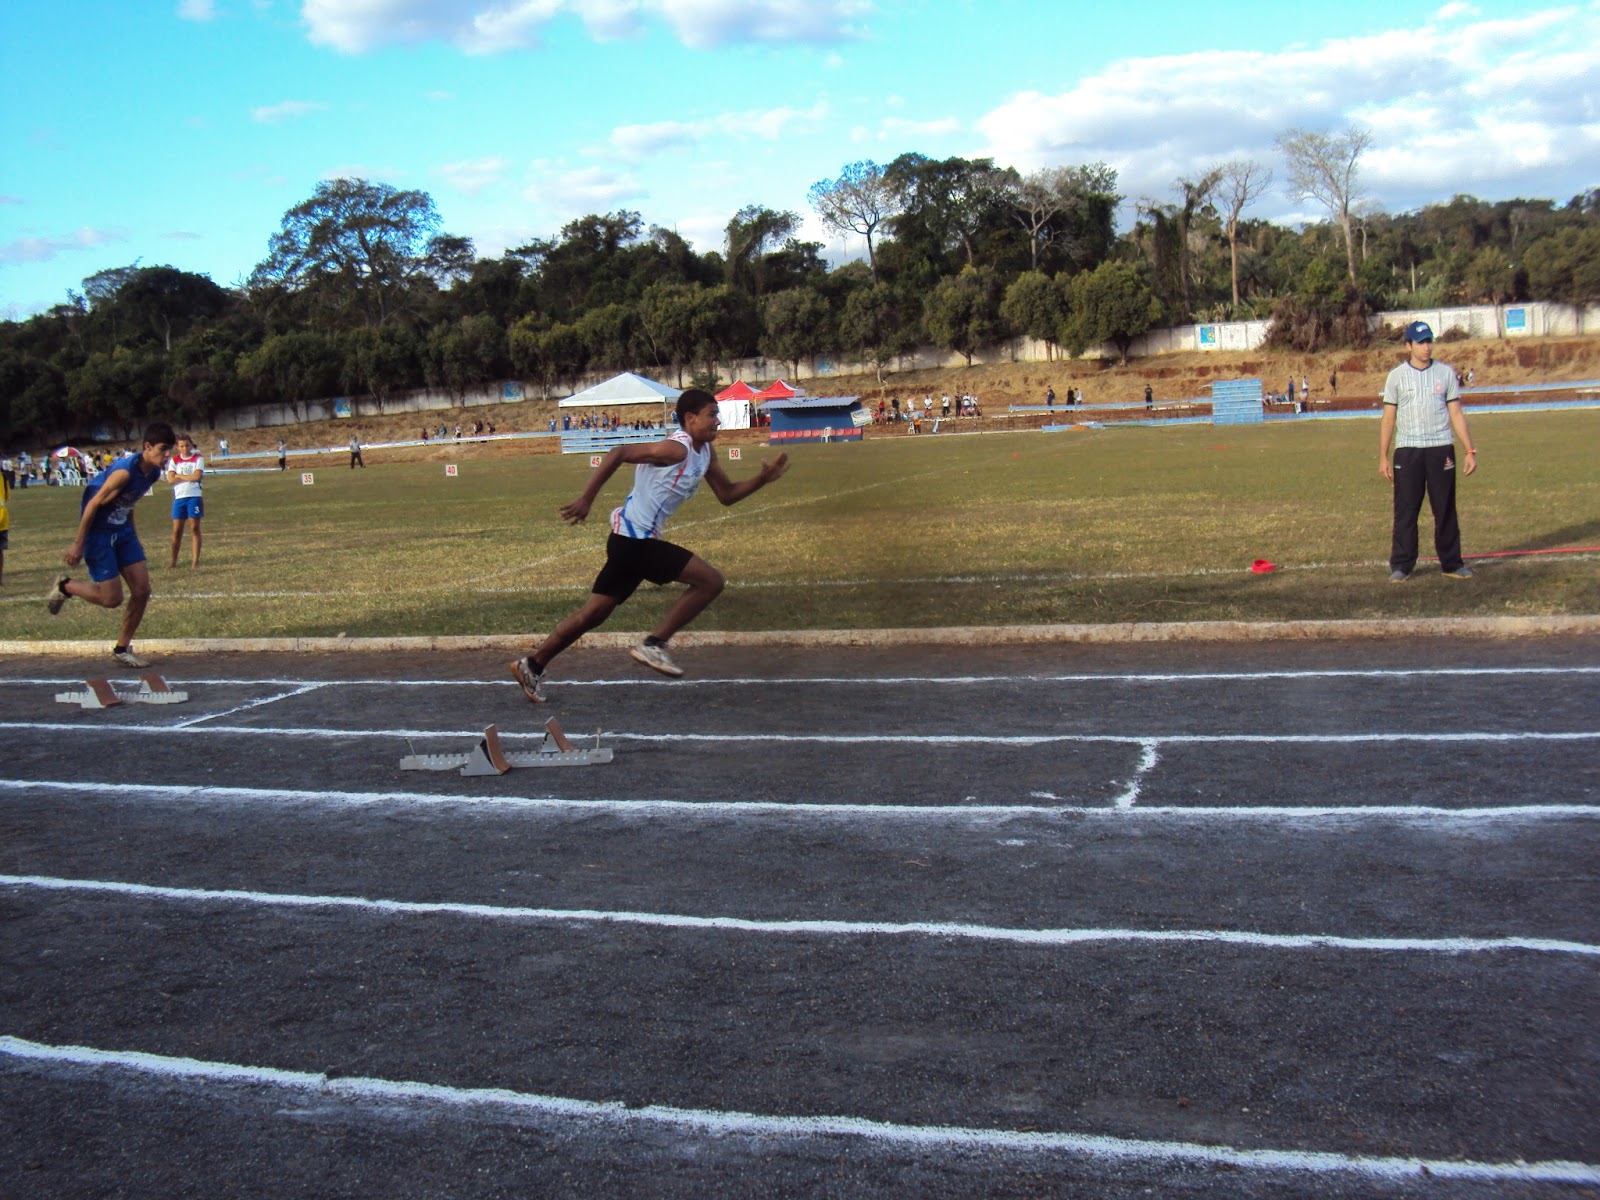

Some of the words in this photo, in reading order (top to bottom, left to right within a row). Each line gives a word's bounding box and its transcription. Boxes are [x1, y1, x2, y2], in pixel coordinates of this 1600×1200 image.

[731, 449, 739, 458] 50
[591, 457, 600, 466] 45
[447, 465, 456, 474] 40
[304, 474, 313, 483] 35
[194, 506, 200, 514] 3
